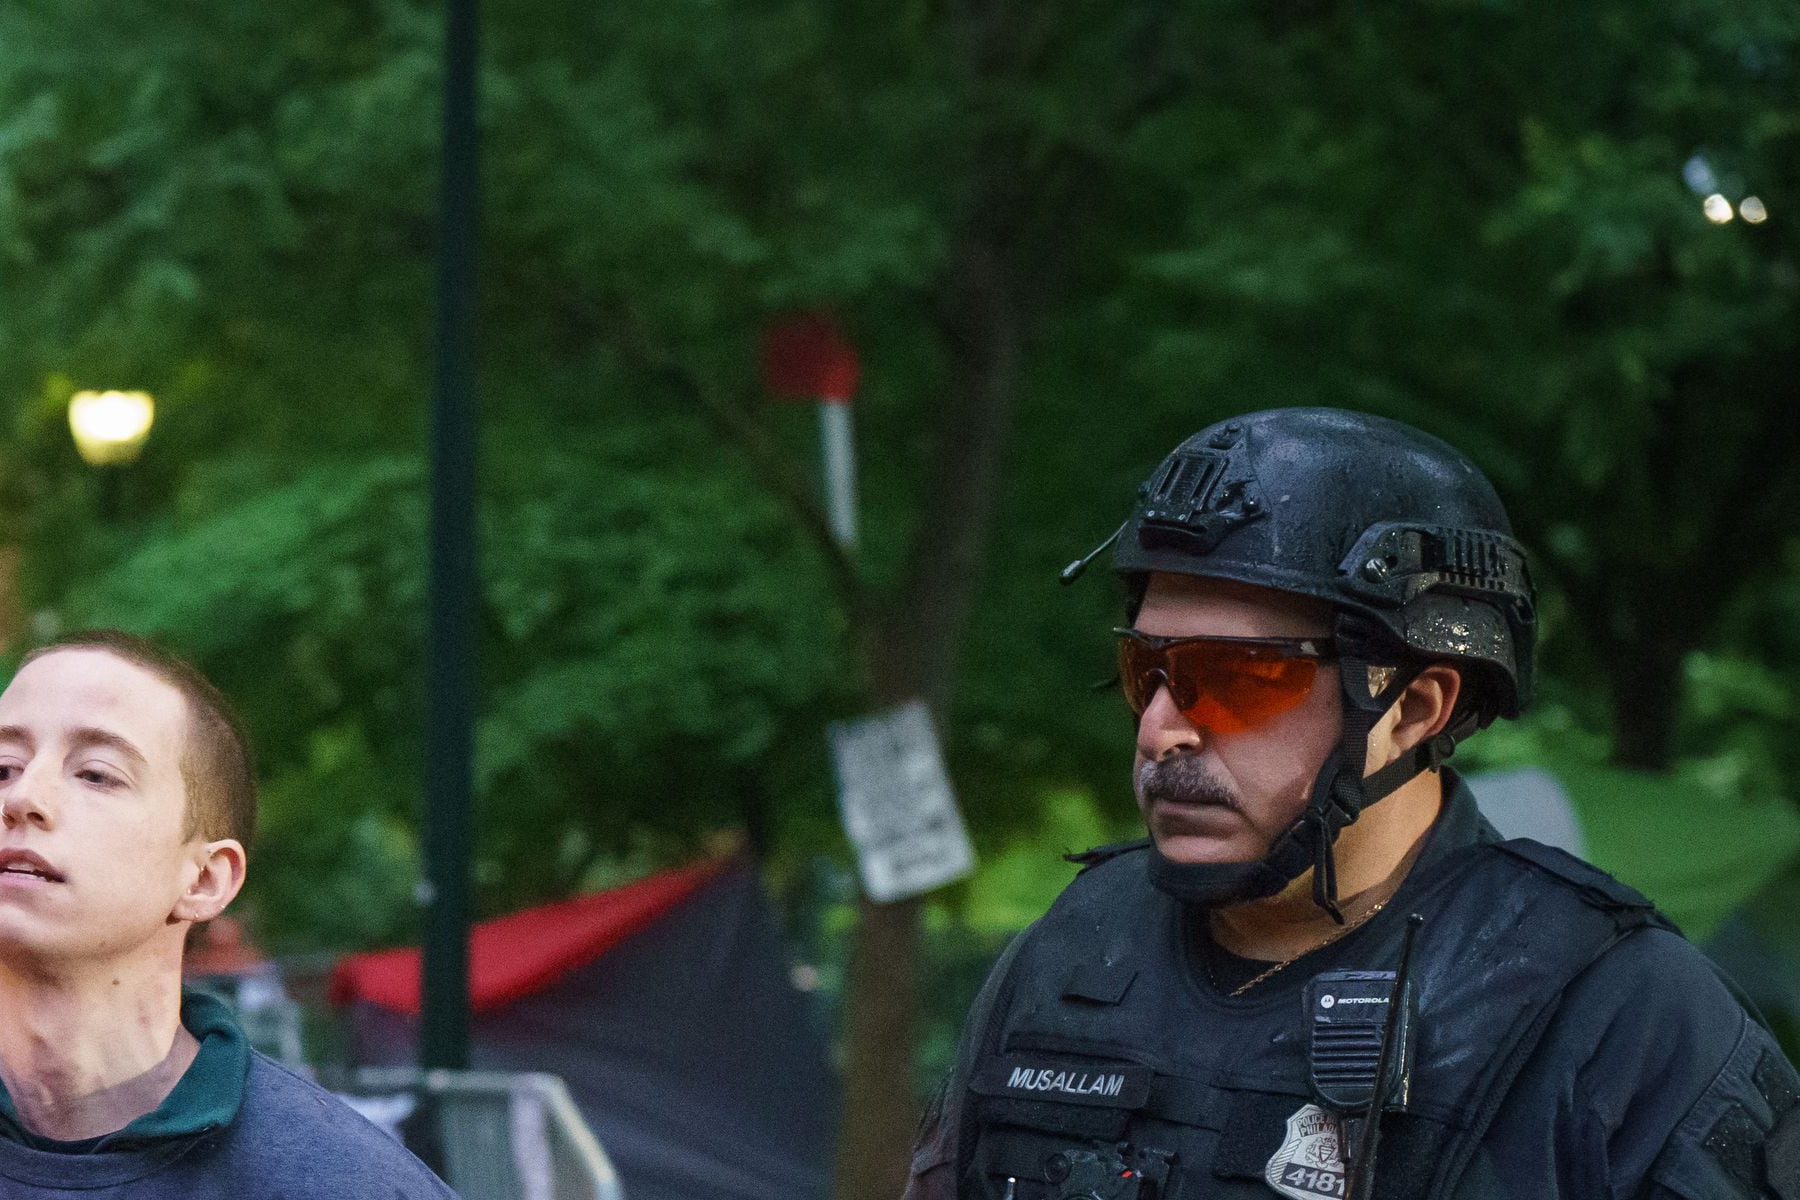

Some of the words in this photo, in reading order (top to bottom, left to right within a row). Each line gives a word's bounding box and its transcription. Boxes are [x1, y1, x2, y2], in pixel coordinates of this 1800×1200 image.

[1337, 997, 1390, 1005] MOTOROLA
[1006, 1066, 1125, 1097] MUSALLAM
[1296, 1113, 1326, 1129] POLICE
